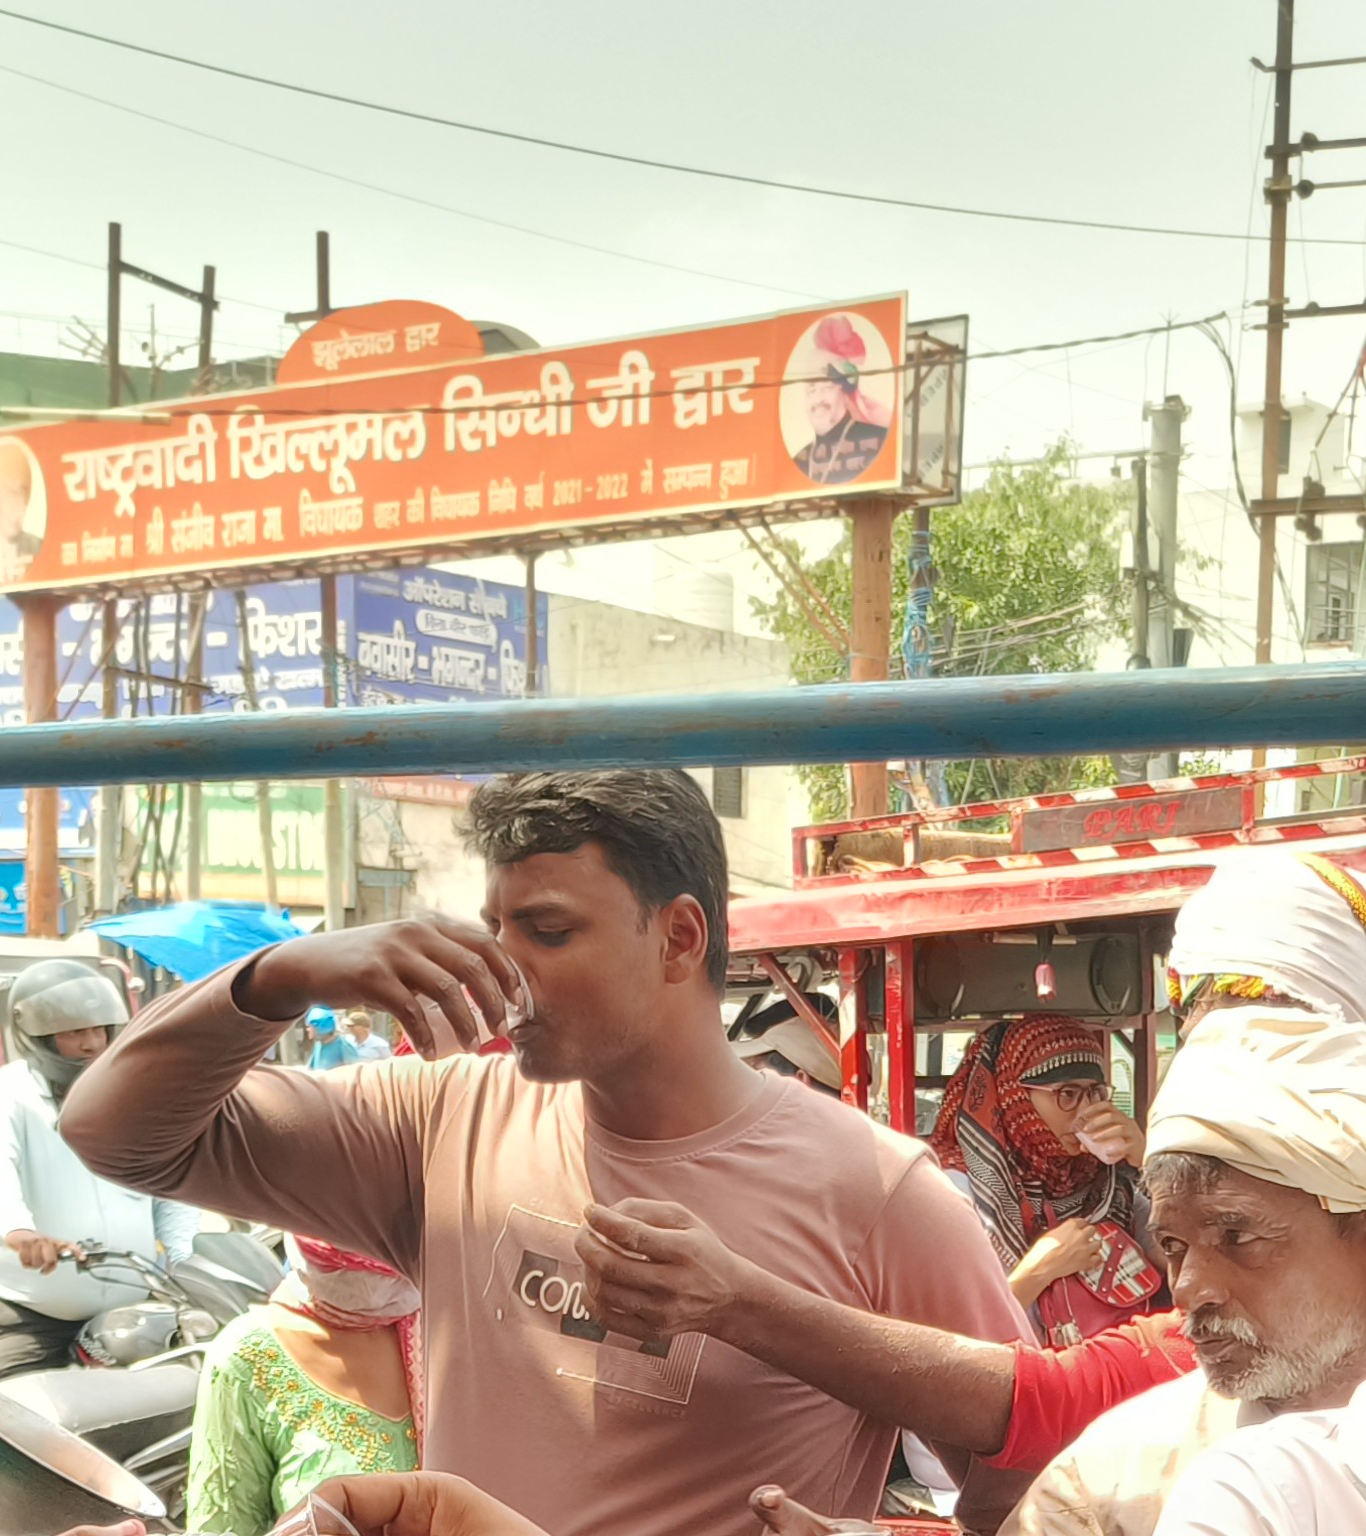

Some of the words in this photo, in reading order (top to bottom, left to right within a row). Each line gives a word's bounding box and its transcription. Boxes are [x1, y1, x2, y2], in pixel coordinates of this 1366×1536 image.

[311, 329, 397, 371] झूलेलाल
[405, 322, 441, 352] द्वार
[62, 413, 217, 518] राष्ट्रवादी
[441, 360, 575, 452] सिन्धी
[586, 350, 655, 428] जी
[670, 357, 761, 429] द्वार
[171, 502, 215, 553] संजीव
[221, 510, 256, 547] राजा
